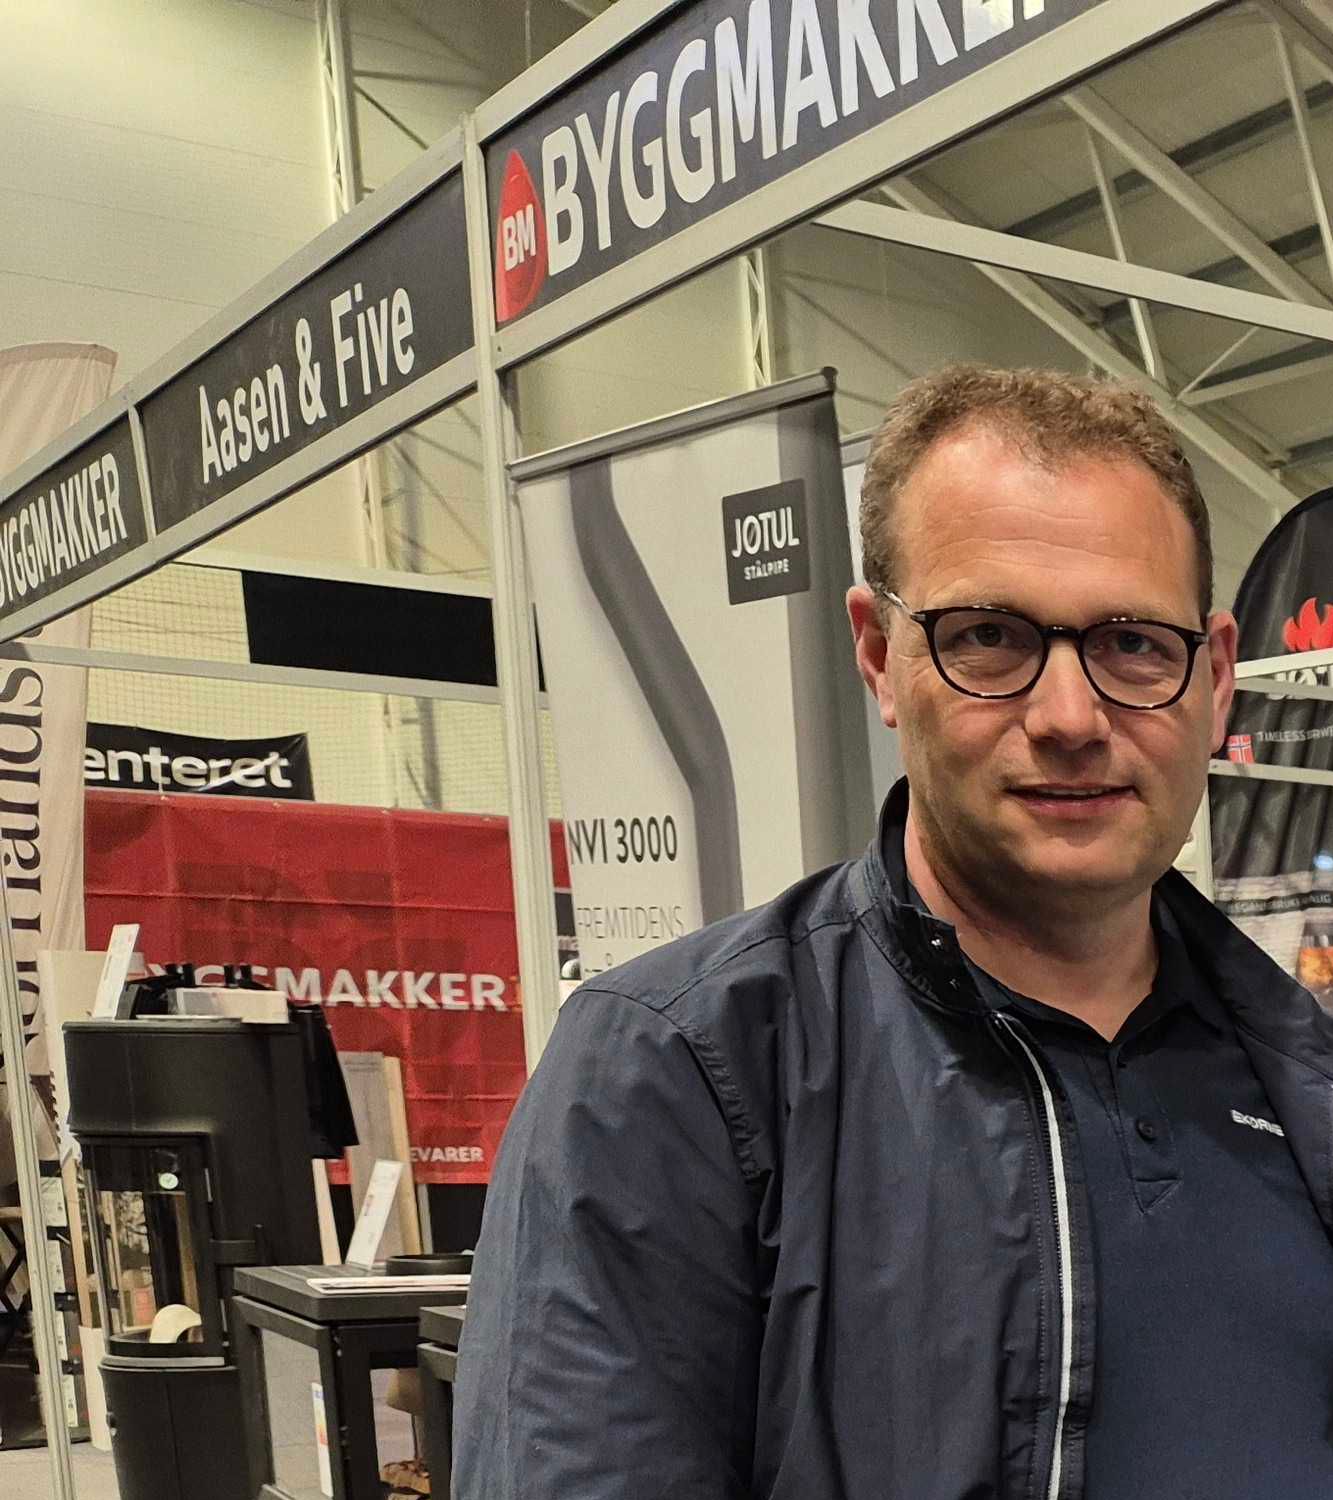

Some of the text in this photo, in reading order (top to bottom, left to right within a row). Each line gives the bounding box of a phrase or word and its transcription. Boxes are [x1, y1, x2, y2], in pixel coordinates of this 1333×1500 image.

[541, 0, 1045, 277] BYGGMAK
[503, 204, 536, 272] BM
[199, 287, 415, 485] Aasen & Five
[0, 453, 128, 604] YGGMAKKER
[731, 506, 800, 558] JØTUL
[744, 558, 789, 580] STÅLPIPE
[85, 747, 292, 789] enteret
[614, 815, 678, 864] 3000
